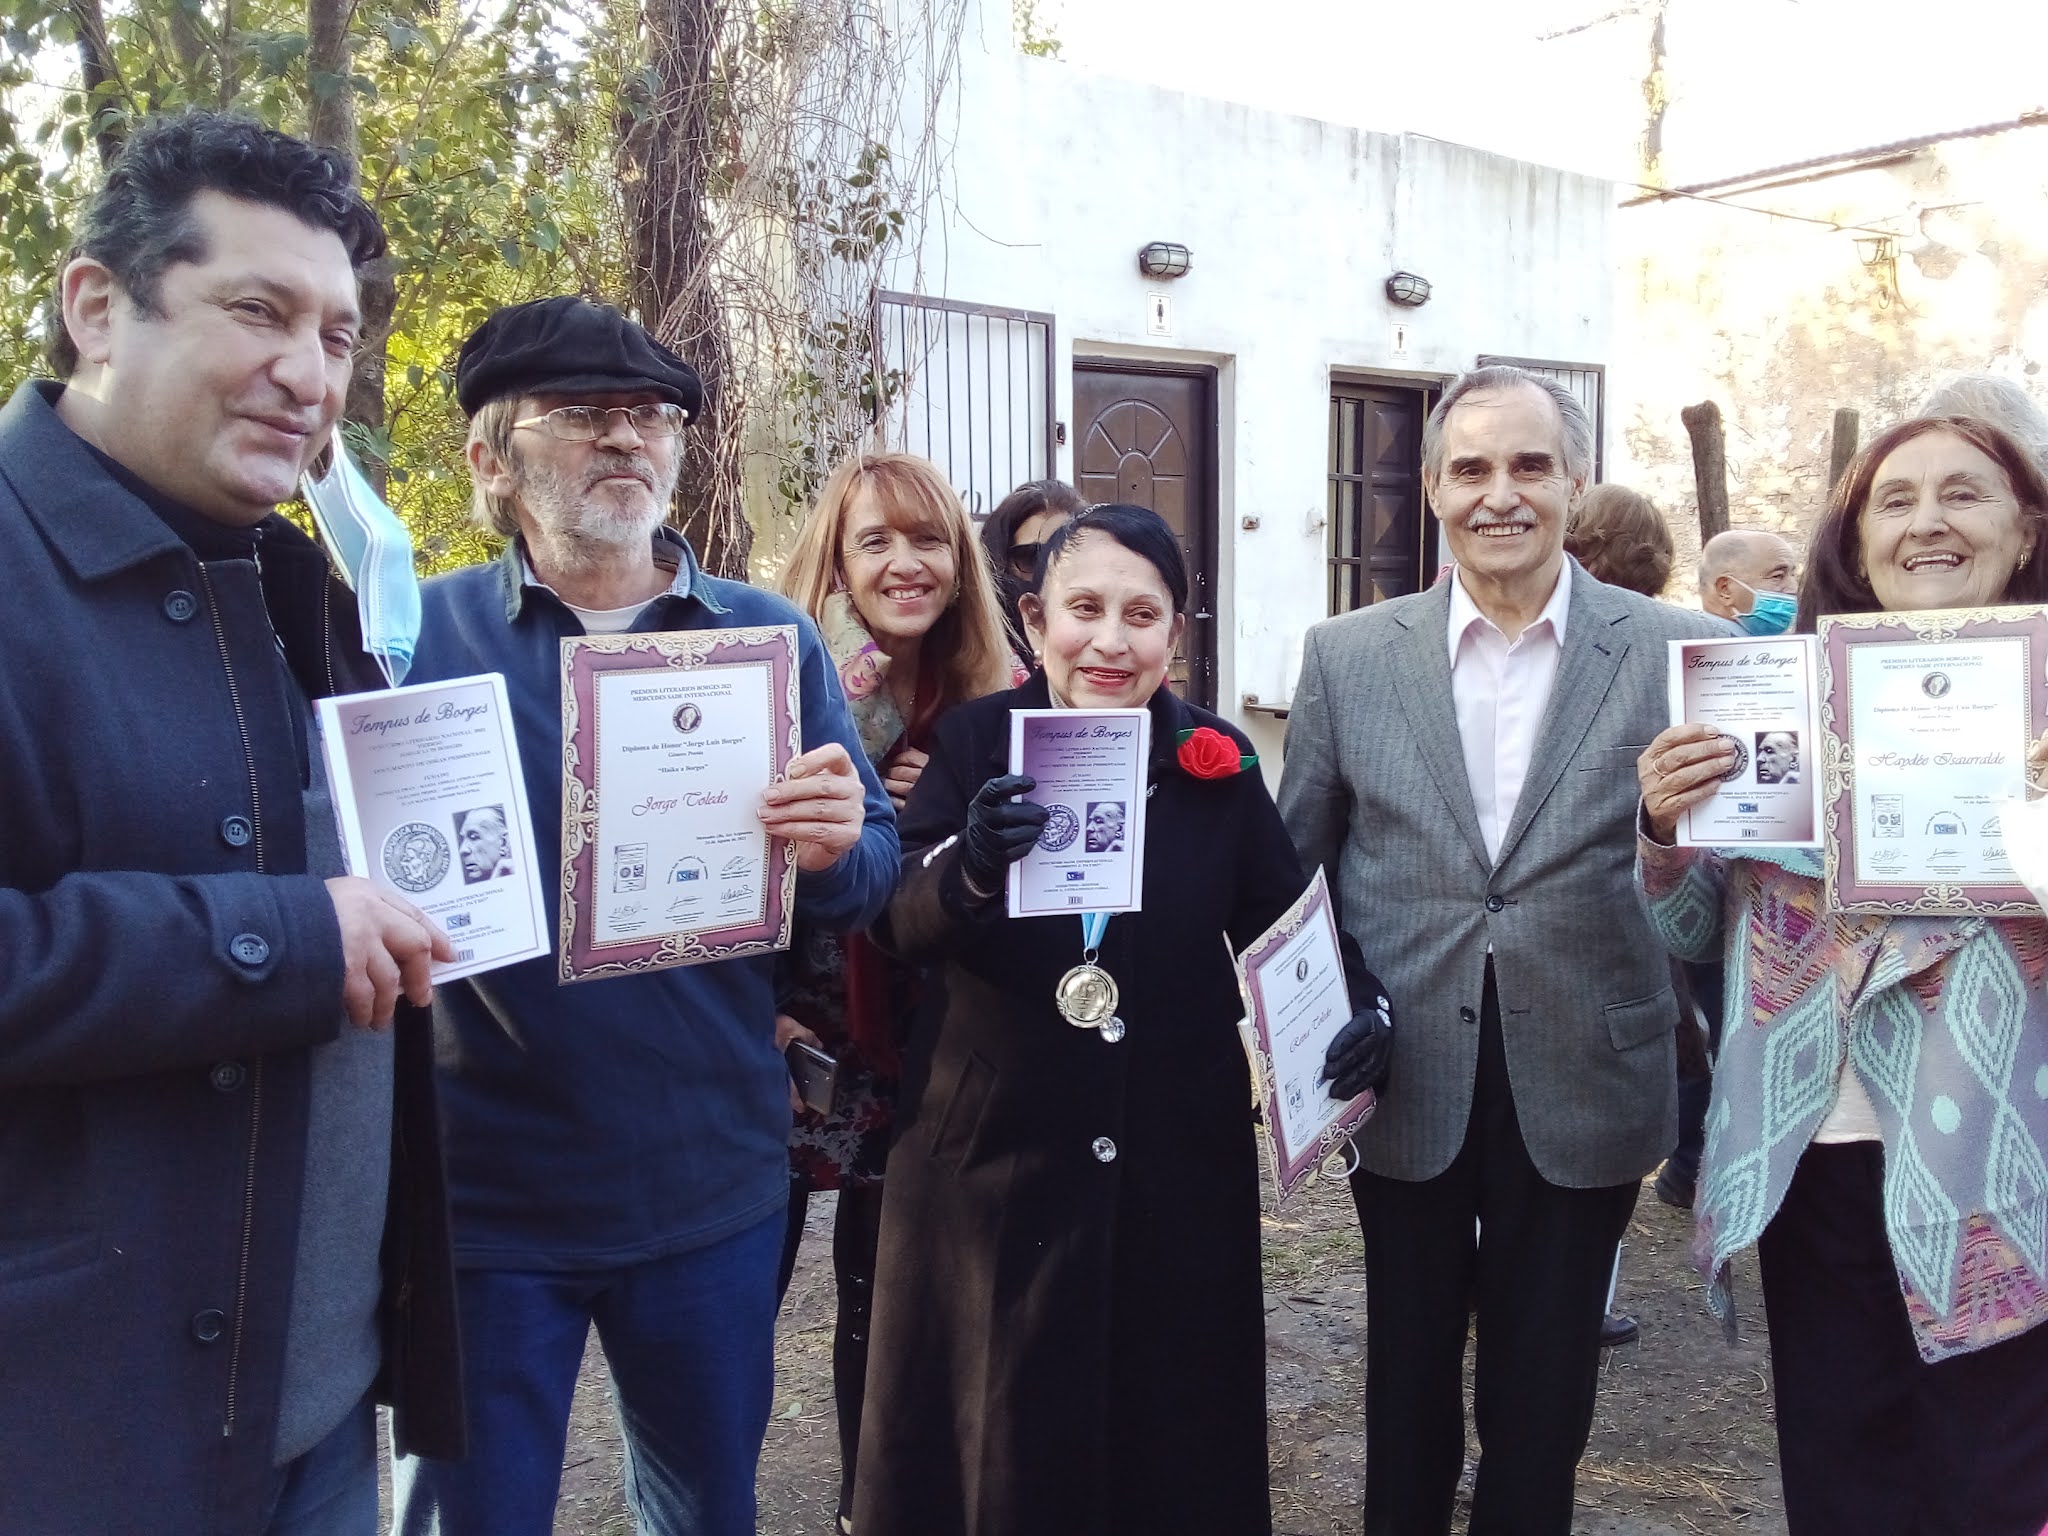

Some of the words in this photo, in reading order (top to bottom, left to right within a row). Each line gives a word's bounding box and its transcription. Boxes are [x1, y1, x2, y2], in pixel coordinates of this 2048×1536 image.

[1688, 655, 1734, 671] Tempus
[1736, 655, 1751, 666] de
[1753, 652, 1798, 668] Borges
[660, 686, 696, 694] LITERARIOS
[684, 690, 732, 699] INTERNACIONAL
[351, 713, 410, 736] Tempus
[414, 707, 431, 724] de
[435, 702, 488, 722] Borges
[1032, 726, 1073, 742] Tempus
[1074, 727, 1088, 738] de
[1090, 725, 1132, 741] Borges
[622, 745, 650, 753] Diploma
[1933, 751, 2006, 767] Isaurralde
[631, 796, 677, 817] Jorge
[683, 790, 729, 808] Toledo
